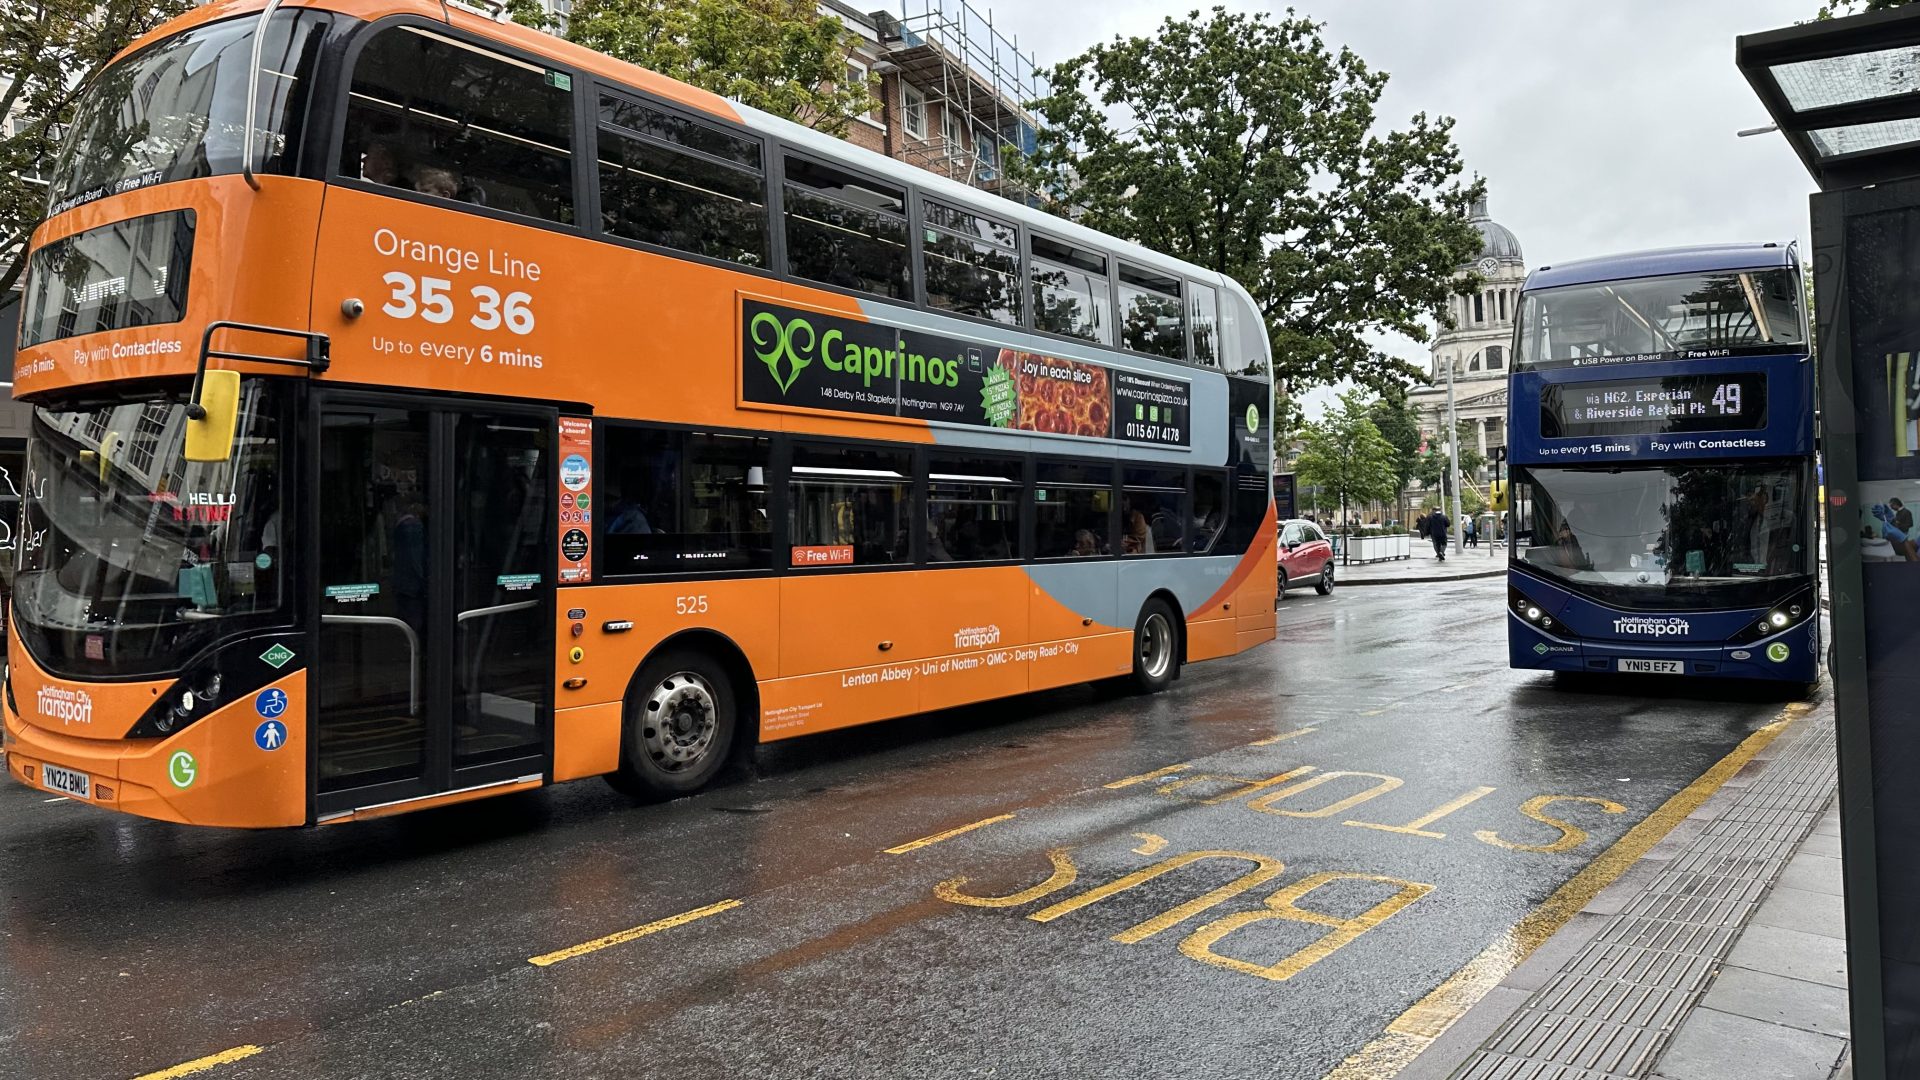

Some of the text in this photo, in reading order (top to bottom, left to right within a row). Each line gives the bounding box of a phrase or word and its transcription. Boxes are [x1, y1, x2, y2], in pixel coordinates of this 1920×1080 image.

[123, 171, 163, 190] Free Wi-Fi
[374, 228, 541, 281] Orange Line
[381, 271, 535, 335] 35 36
[74, 339, 182, 367] Pay with Contactless
[372, 336, 543, 368] Up to every 6 mins
[820, 329, 959, 388] Caprinos
[1600, 356, 1624, 364] Power
[1638, 353, 1661, 361] Board
[1688, 349, 1730, 358] Free Wi-Fi
[33, 359, 38, 373] 6
[38, 357, 55, 372] mins
[1022, 360, 1092, 383] Joy in each slice
[820, 387, 833, 398] 148
[834, 389, 854, 401] Derby
[867, 393, 899, 405] Staplefor
[901, 398, 938, 410] Nottingham
[940, 402, 953, 411] NG9
[954, 403, 965, 412] 7AY
[1116, 387, 1189, 407] www.caprinospizza.co.uk
[1586, 393, 1600, 404] via
[1636, 389, 1691, 402] Experian
[1711, 383, 1741, 415] 49
[1586, 405, 1644, 419] Riverside
[1648, 403, 1685, 416] Retail
[1126, 422, 1180, 441] 0115 671 4178
[1539, 448, 1550, 456] Up
[1560, 446, 1588, 455] every
[1590, 444, 1602, 453] 15
[1604, 443, 1631, 452] mins
[1651, 438, 1766, 453] Pay with Contactless
[189, 493, 236, 505] HELLO
[807, 548, 852, 561] Free Wi-Fi
[676, 595, 708, 615] 525
[1613, 620, 1690, 637] Transport
[1621, 616, 1686, 626] Nottingham City
[954, 628, 1000, 648] Transport
[959, 626, 988, 636] Nottingham
[267, 652, 287, 661] CNG
[842, 642, 1080, 688] Lenton Abbey Uni of Nottm QMC Derby Road City
[1625, 660, 1678, 673] YN19 EFZ
[42, 684, 90, 704] Nottingham City
[37, 690, 92, 725] Transport
[45, 766, 86, 796] YN22 BMU
[934, 831, 1438, 982] BUS
